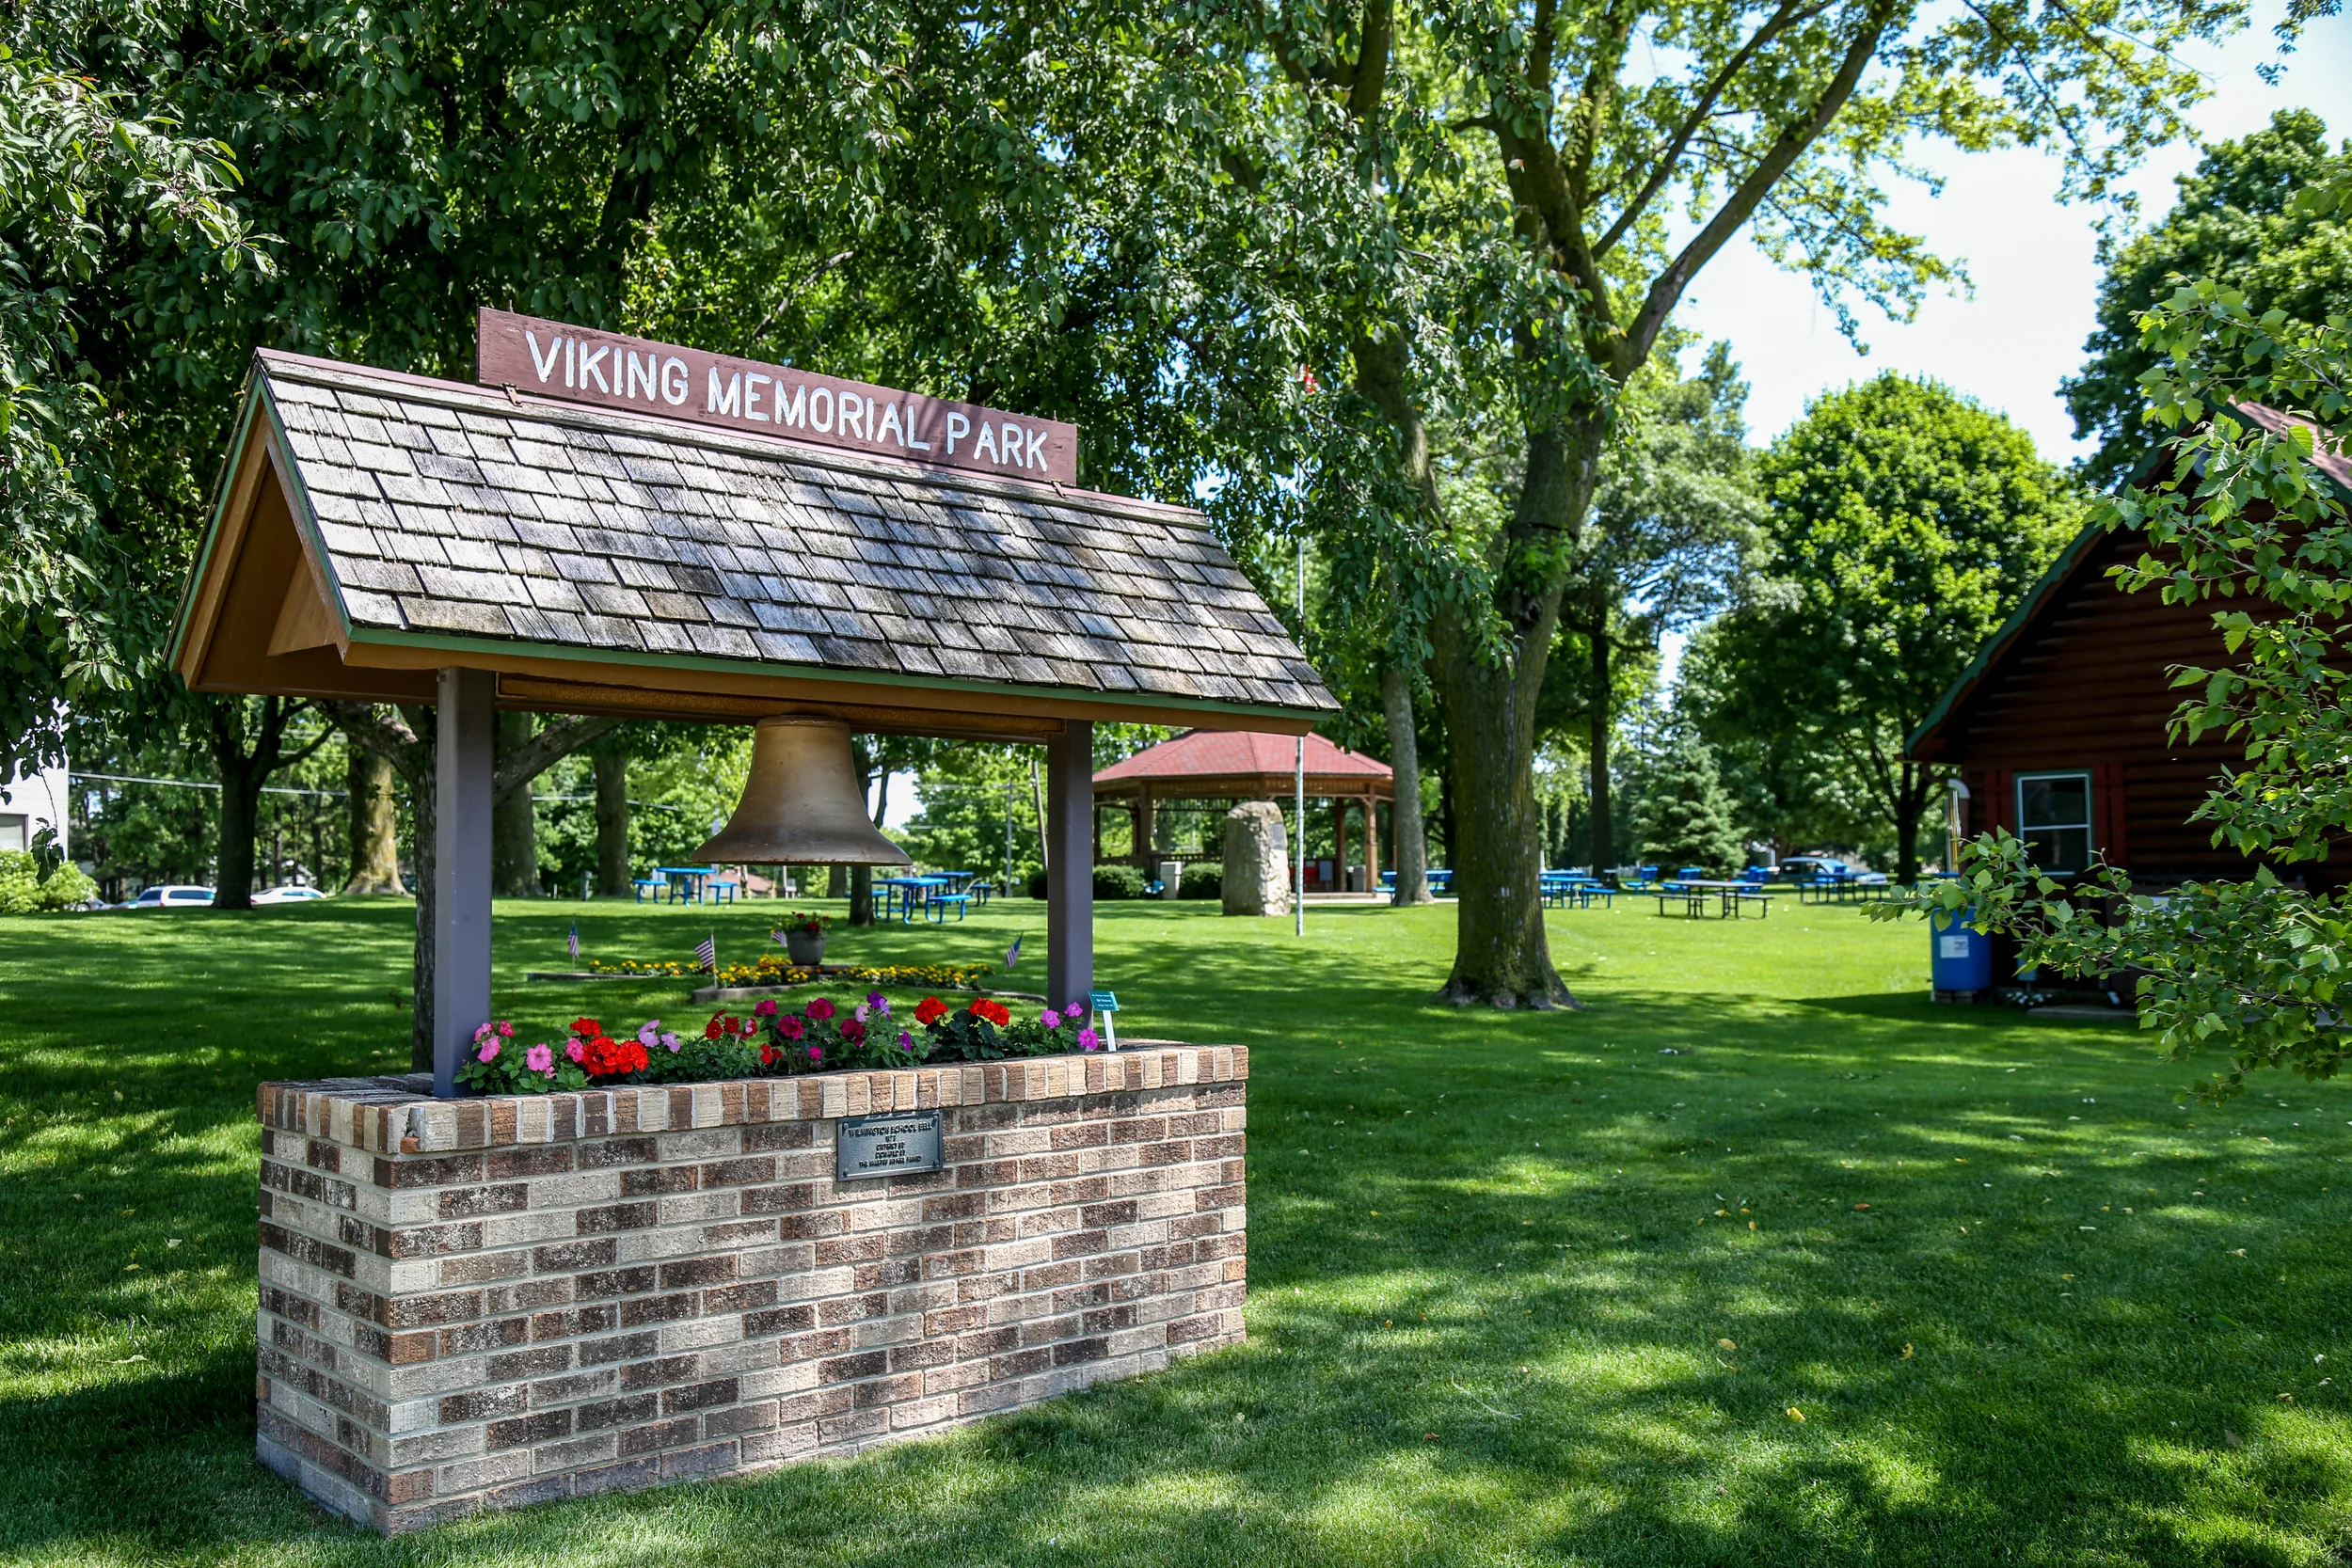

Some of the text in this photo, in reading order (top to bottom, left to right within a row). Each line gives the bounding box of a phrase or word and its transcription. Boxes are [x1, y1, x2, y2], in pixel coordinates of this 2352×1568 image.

[525, 330, 1048, 471] VIKING MEMORIAL PARK
[890, 1123, 917, 1135] SCHOOL
[918, 1120, 932, 1132] BELL
